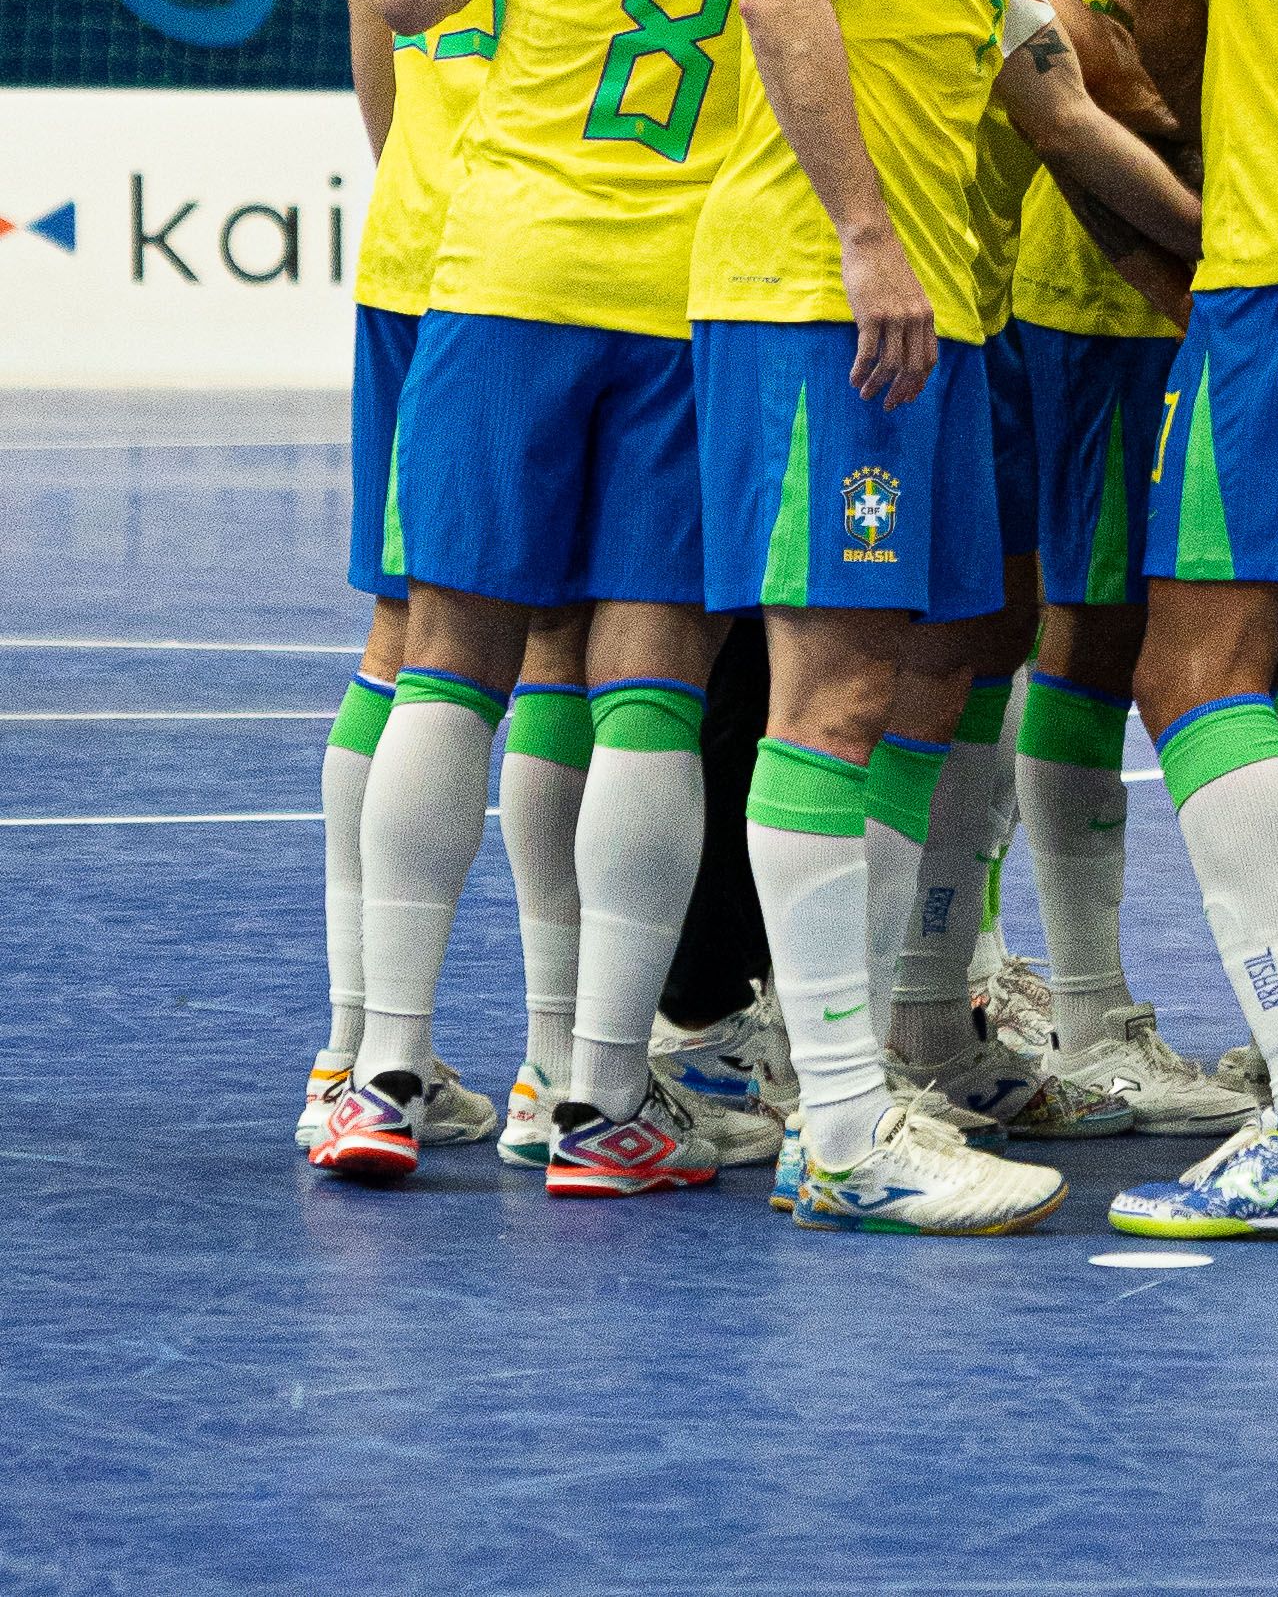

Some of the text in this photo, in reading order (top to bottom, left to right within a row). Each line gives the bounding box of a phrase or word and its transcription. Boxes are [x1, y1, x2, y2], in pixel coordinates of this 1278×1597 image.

[130, 171, 342, 285] kai
[860, 506, 881, 515] CBF
[843, 549, 899, 563] BRASIL
